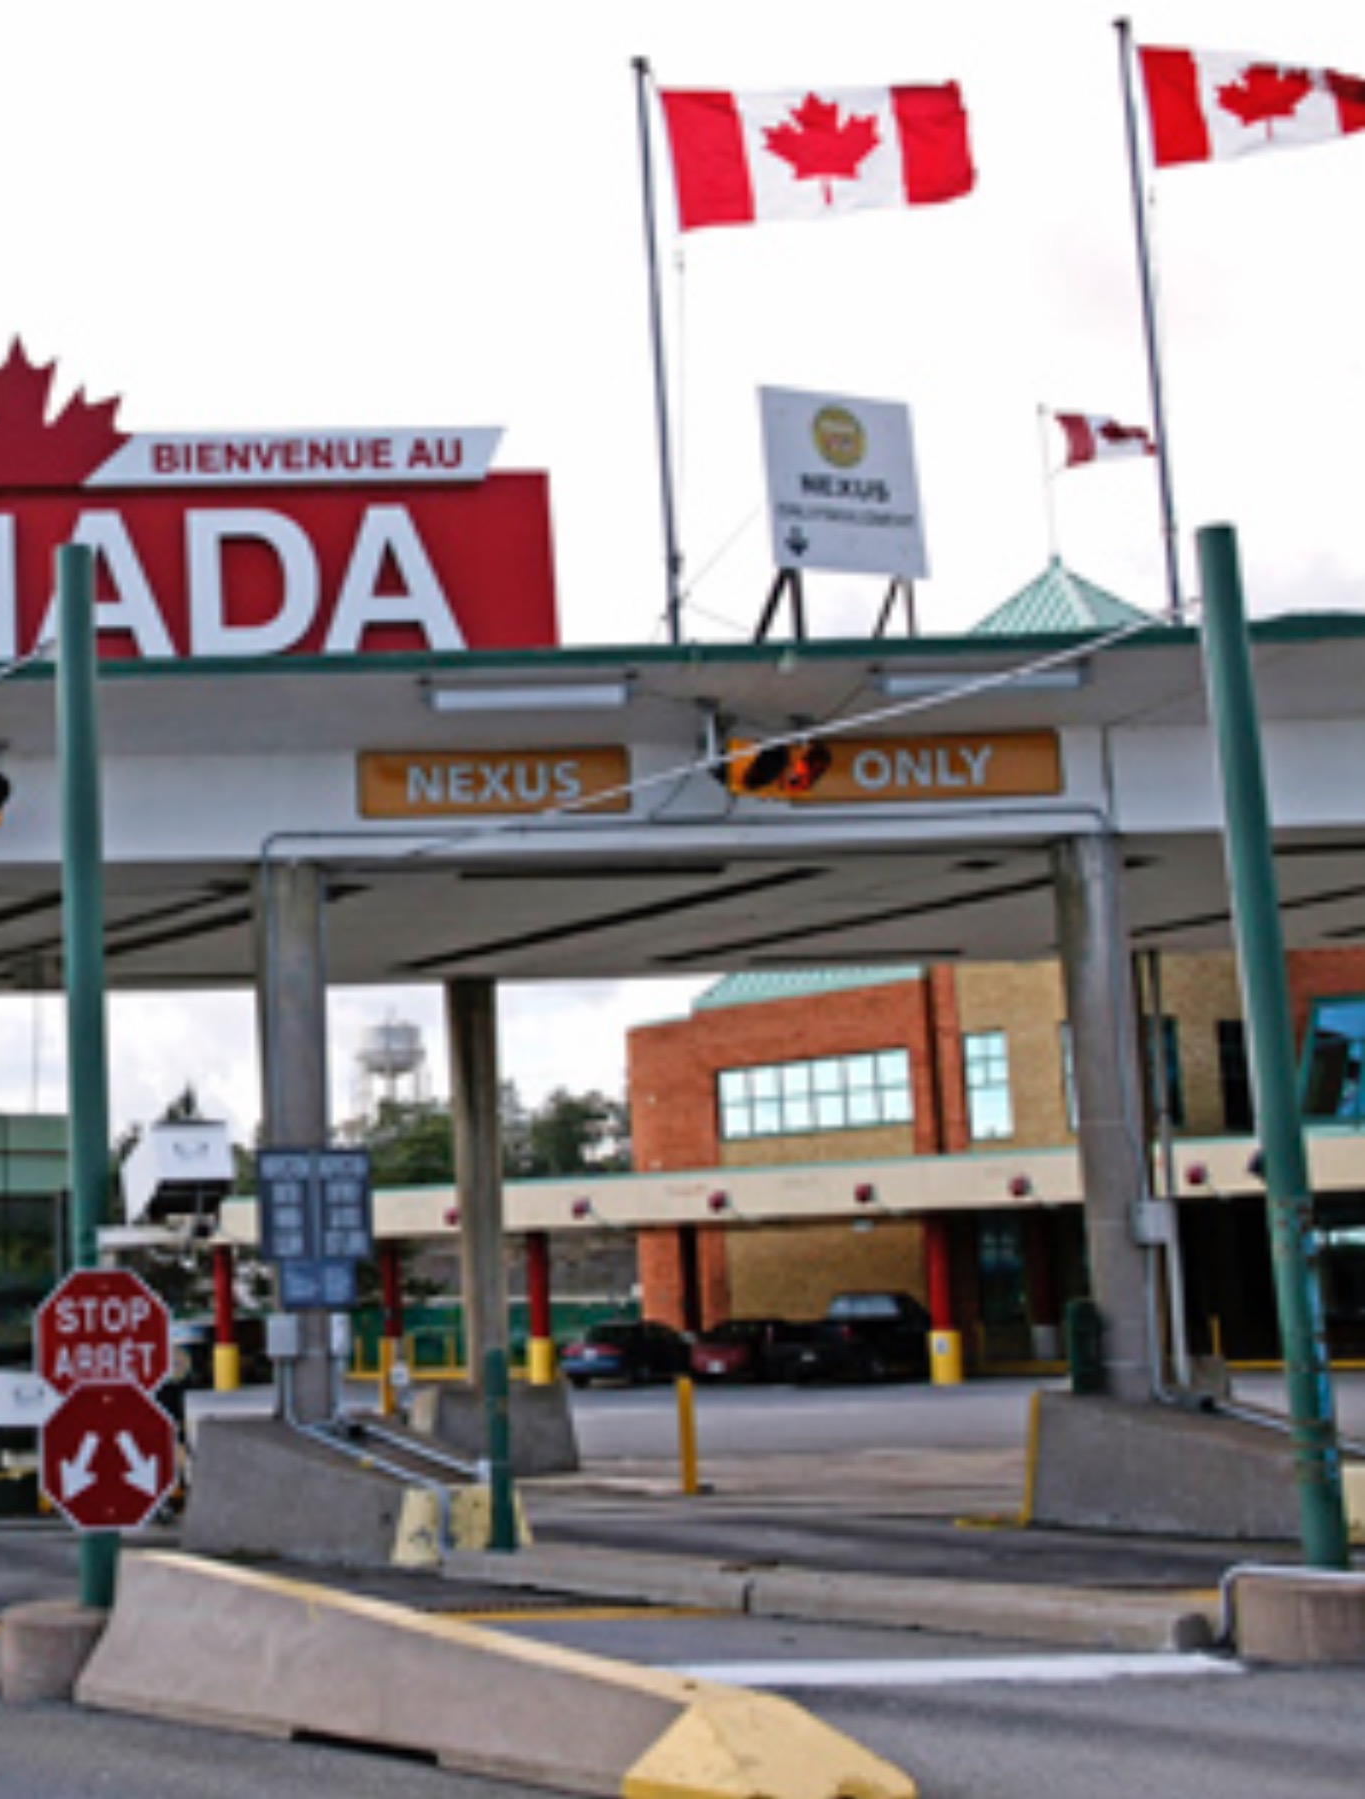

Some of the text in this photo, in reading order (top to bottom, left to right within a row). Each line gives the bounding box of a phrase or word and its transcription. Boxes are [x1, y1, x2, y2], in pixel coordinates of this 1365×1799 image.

[152, 438, 463, 473] BIENVENUE AU
[406, 744, 994, 802] NEXUS ONLY
[55, 1295, 151, 1333] STOP
